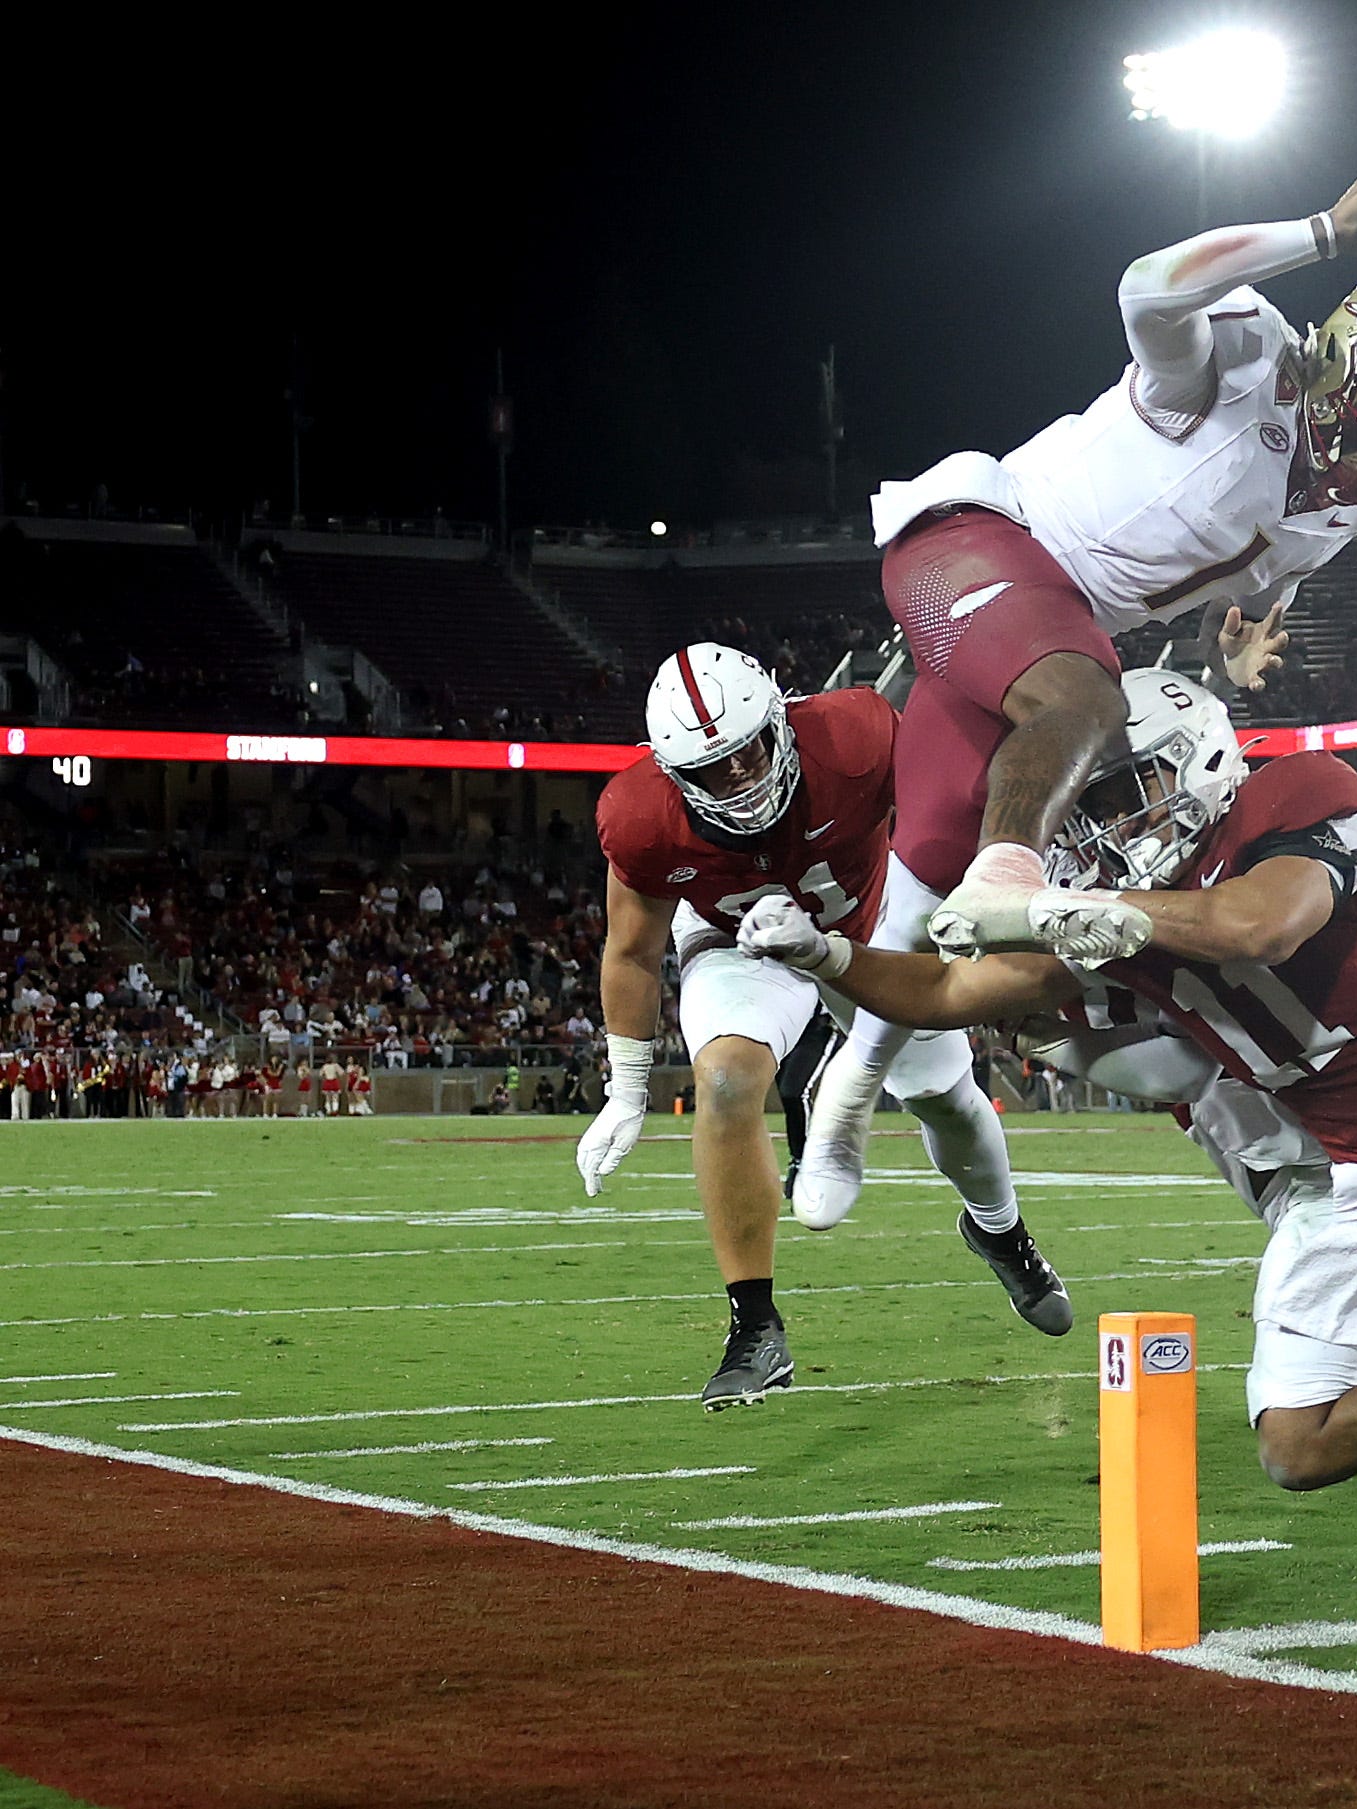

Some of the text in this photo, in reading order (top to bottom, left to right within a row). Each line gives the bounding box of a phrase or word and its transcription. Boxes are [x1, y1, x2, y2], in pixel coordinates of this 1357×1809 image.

[1160, 682, 1193, 711] S
[52, 755, 92, 786] 40
[1171, 965, 1355, 1094] 11
[1151, 1344, 1182, 1358] ACC
